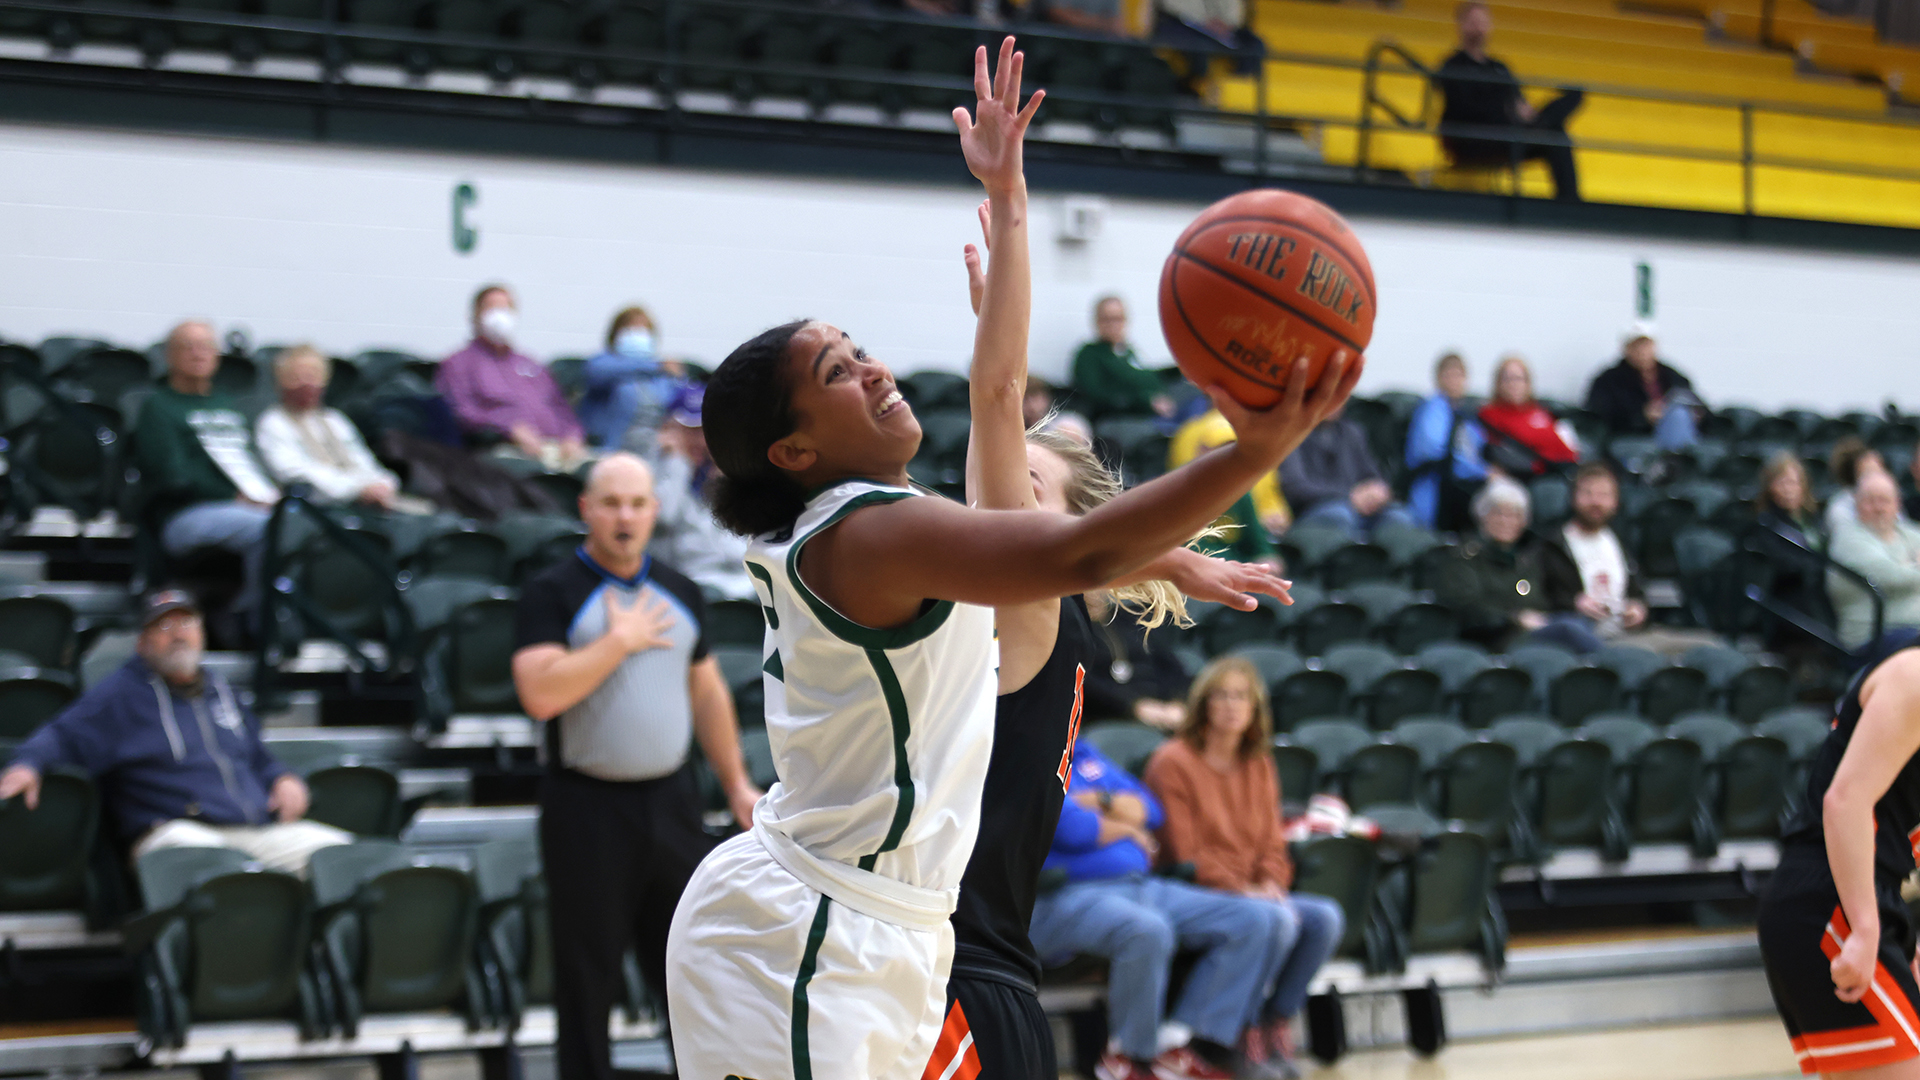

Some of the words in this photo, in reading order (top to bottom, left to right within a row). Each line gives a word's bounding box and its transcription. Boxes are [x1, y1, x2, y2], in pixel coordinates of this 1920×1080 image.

[451, 182, 478, 254] C
[1226, 231, 1298, 282] THE
[1295, 249, 1365, 326] ROCK
